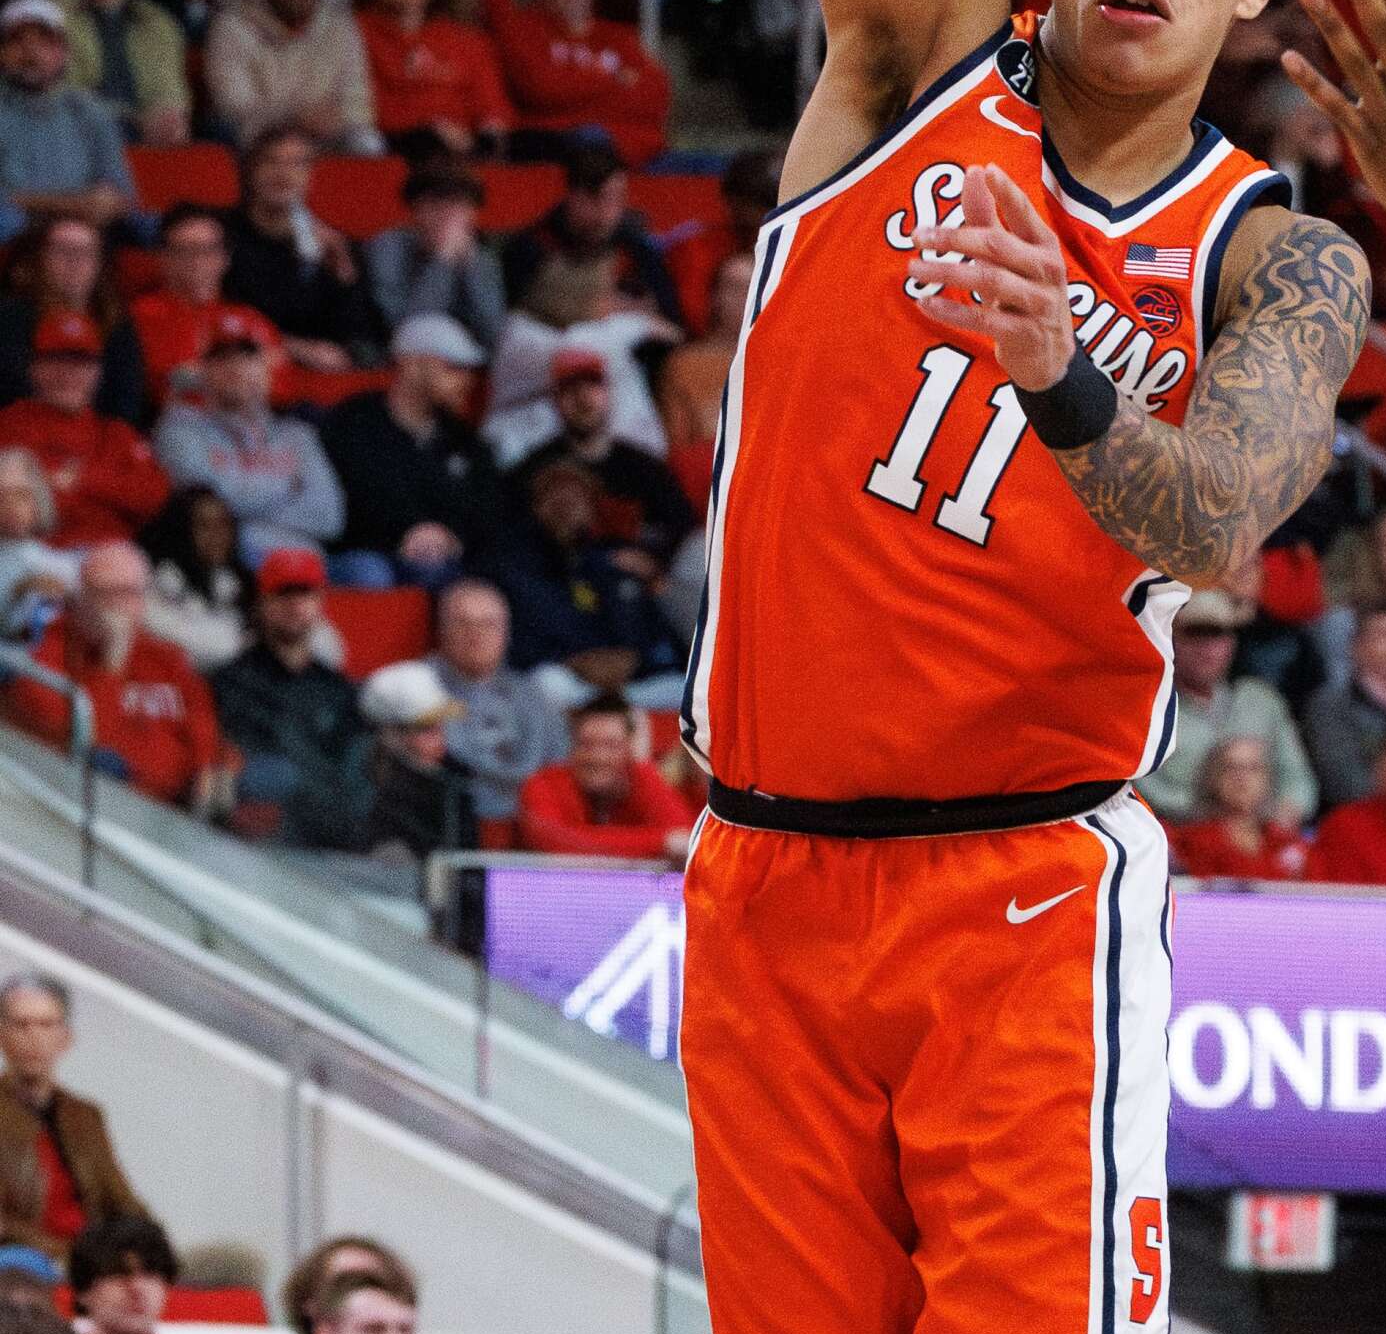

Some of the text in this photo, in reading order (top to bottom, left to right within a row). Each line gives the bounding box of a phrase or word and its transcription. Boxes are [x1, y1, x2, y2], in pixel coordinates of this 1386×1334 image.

[885, 161, 1187, 412] Scuse
[863, 343, 1028, 548] 11
[1129, 1195, 1162, 1324] S
